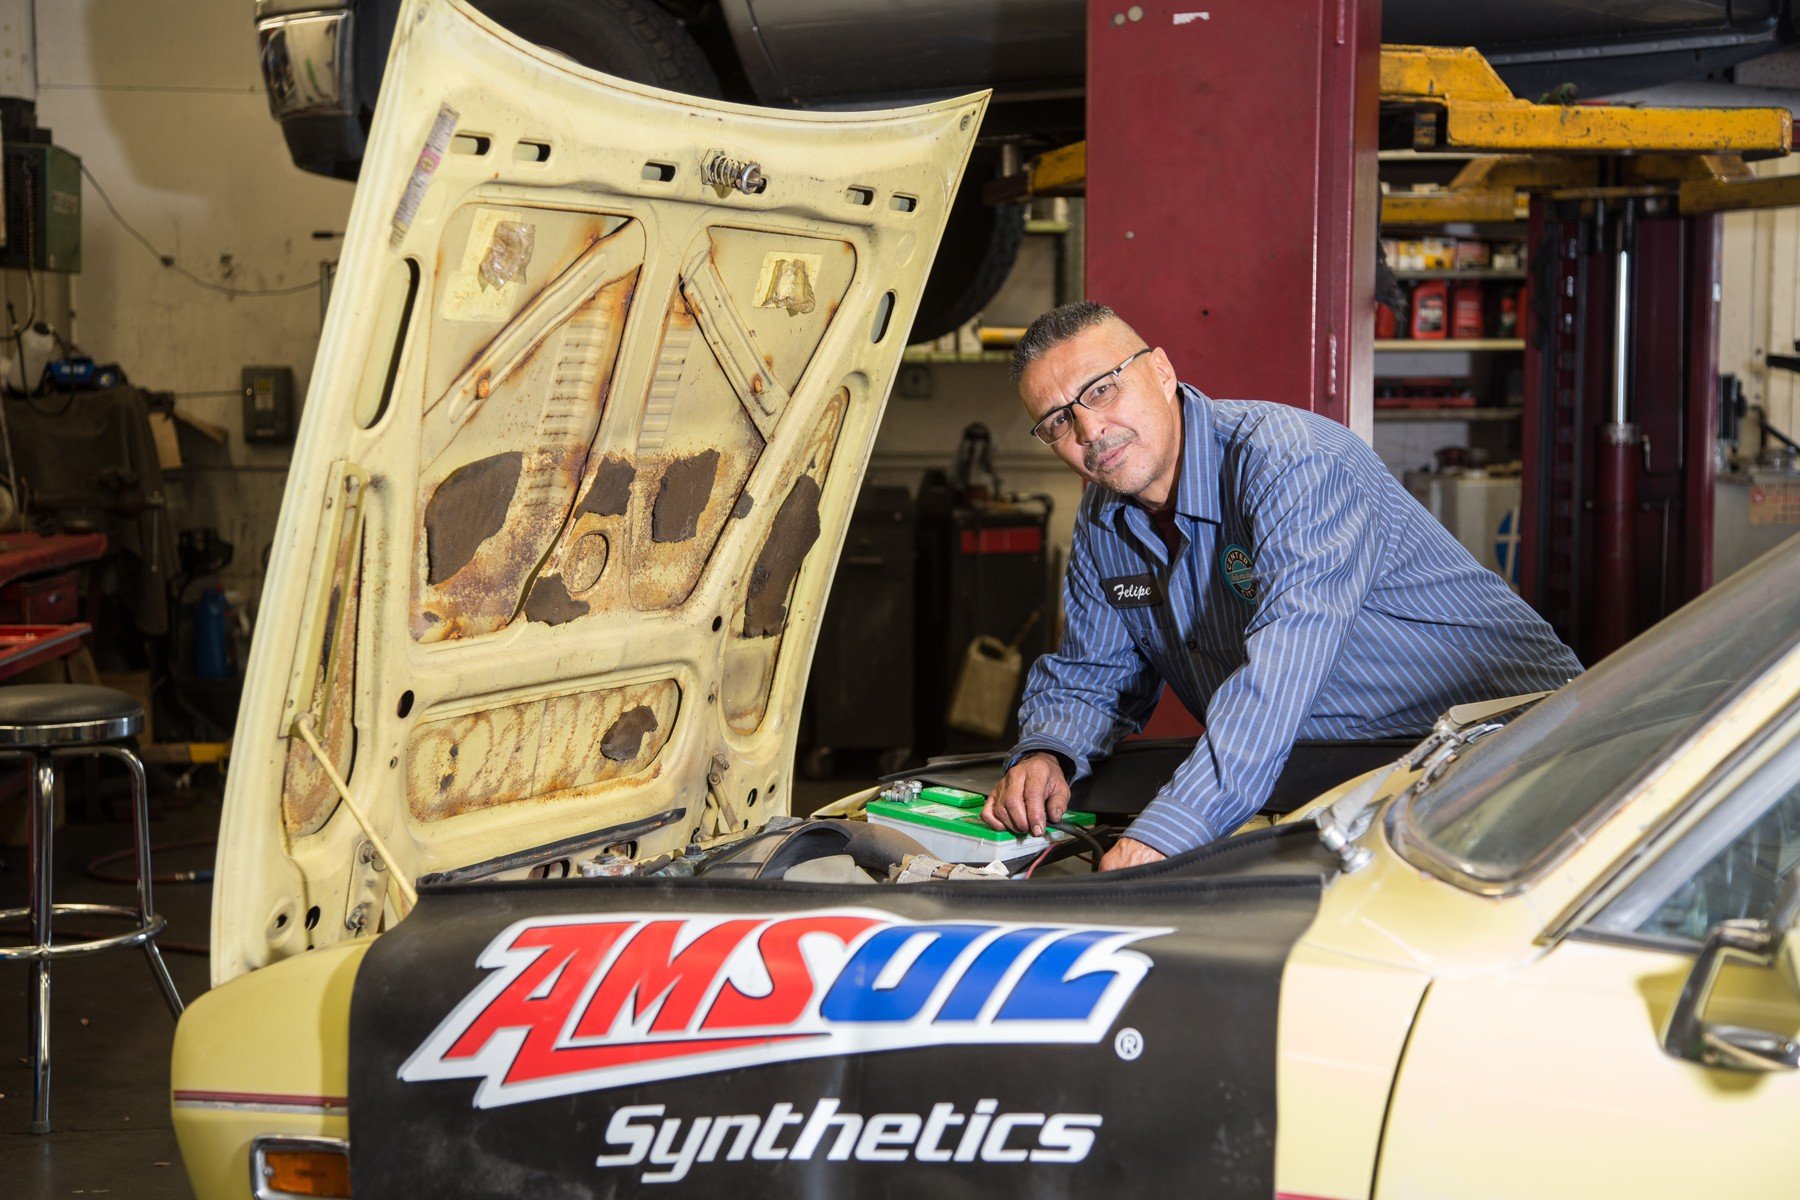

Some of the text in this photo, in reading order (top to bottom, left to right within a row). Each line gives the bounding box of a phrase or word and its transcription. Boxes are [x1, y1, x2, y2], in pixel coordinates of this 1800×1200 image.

[1227, 551, 1249, 570] CENTER
[1113, 583, 1152, 601] Felipe
[430, 912, 1146, 1094] AMSOIL
[596, 1097, 1103, 1184] Synthetics
